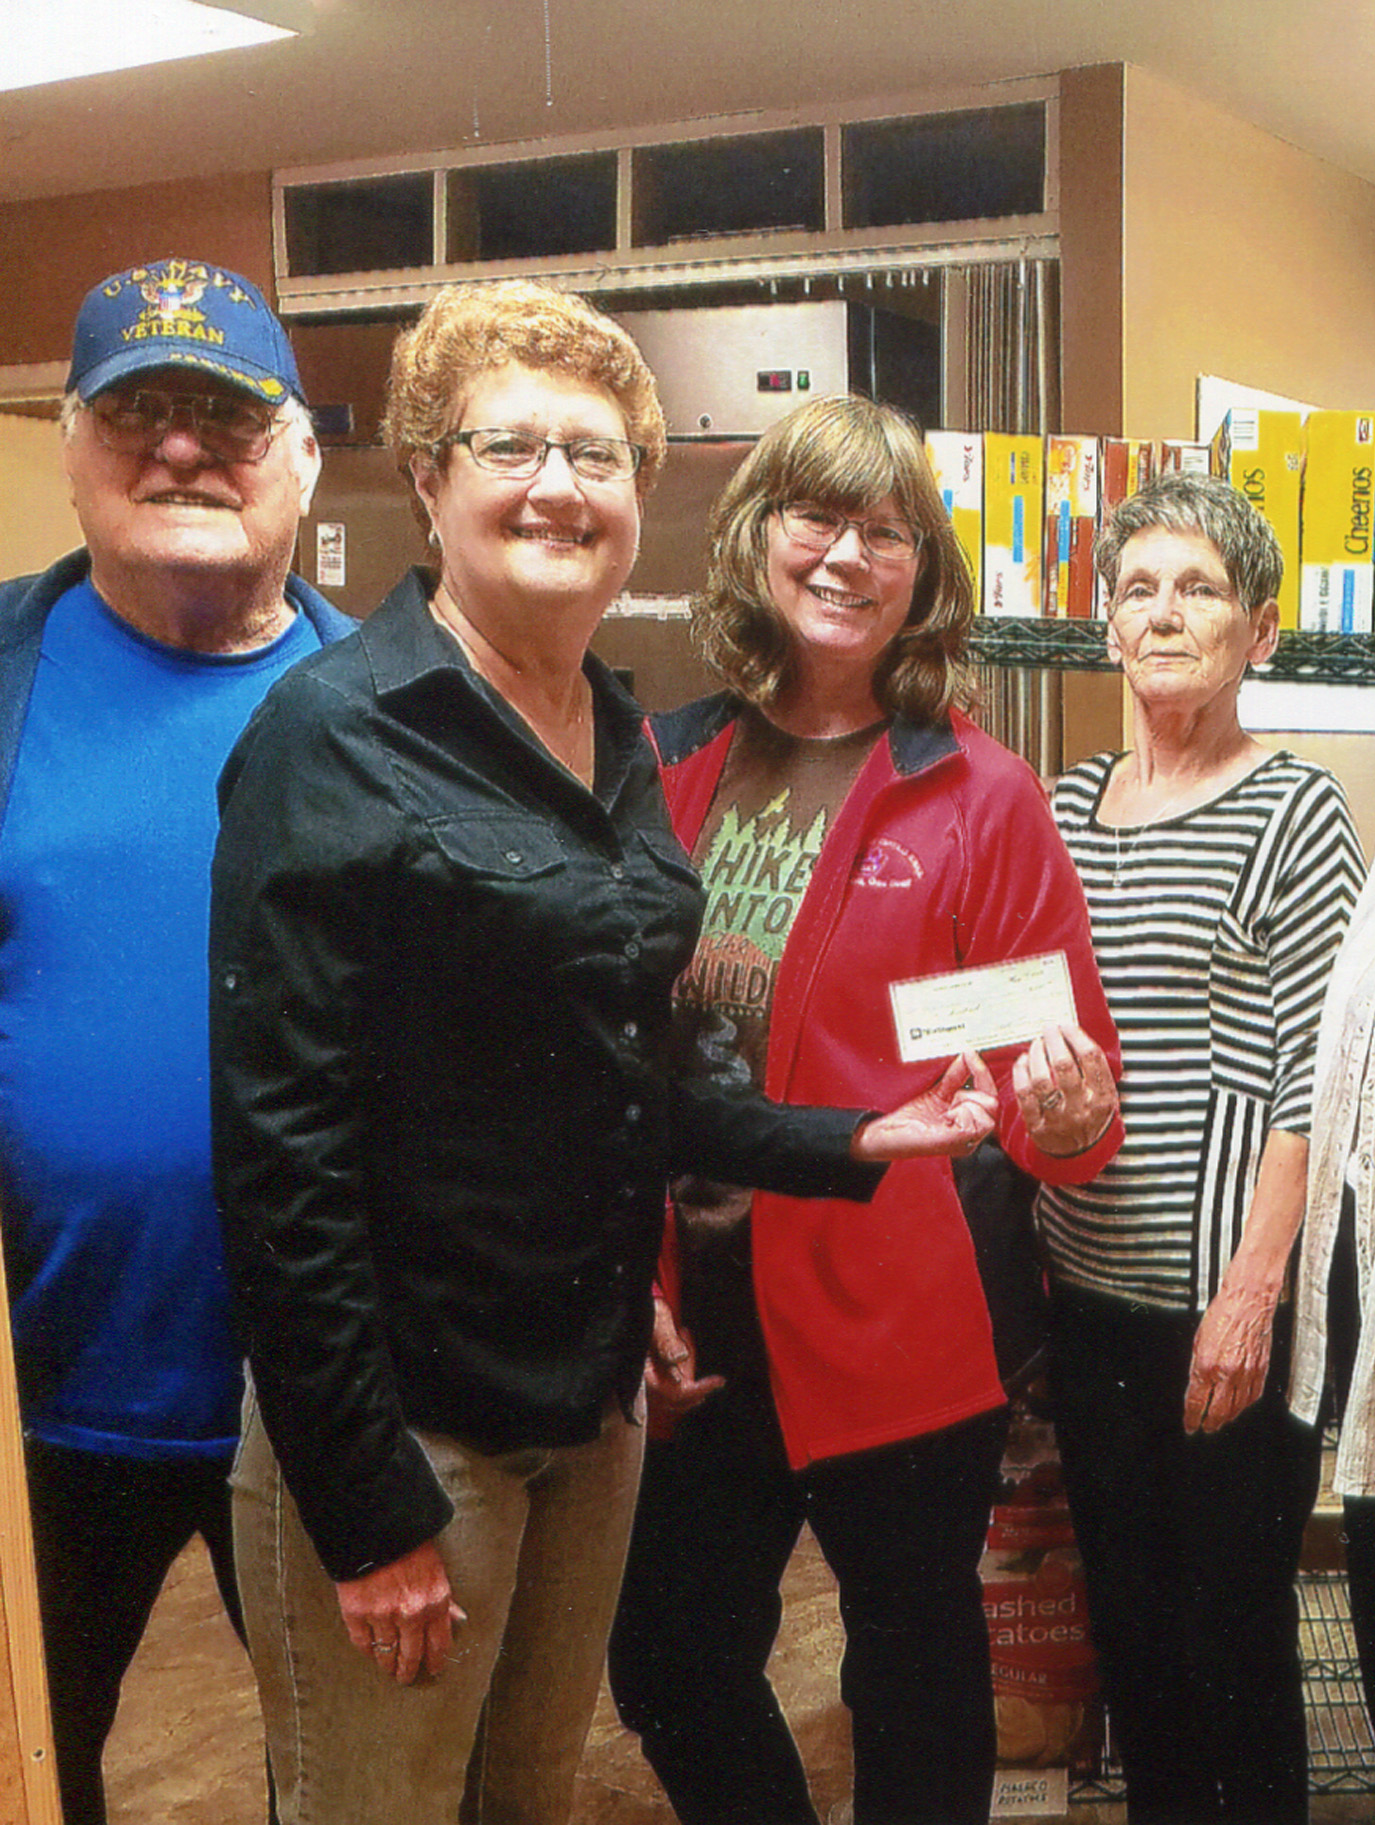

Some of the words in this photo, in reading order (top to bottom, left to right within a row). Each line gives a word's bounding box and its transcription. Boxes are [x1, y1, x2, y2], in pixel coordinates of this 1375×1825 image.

[121, 318, 226, 346] VETERAN
[708, 838, 821, 894] HIKE
[708, 891, 794, 934] NTO
[982, 1592, 1076, 1619] ashed
[988, 1623, 1086, 1646] atoes
[991, 1662, 1047, 1684] EGULAR
